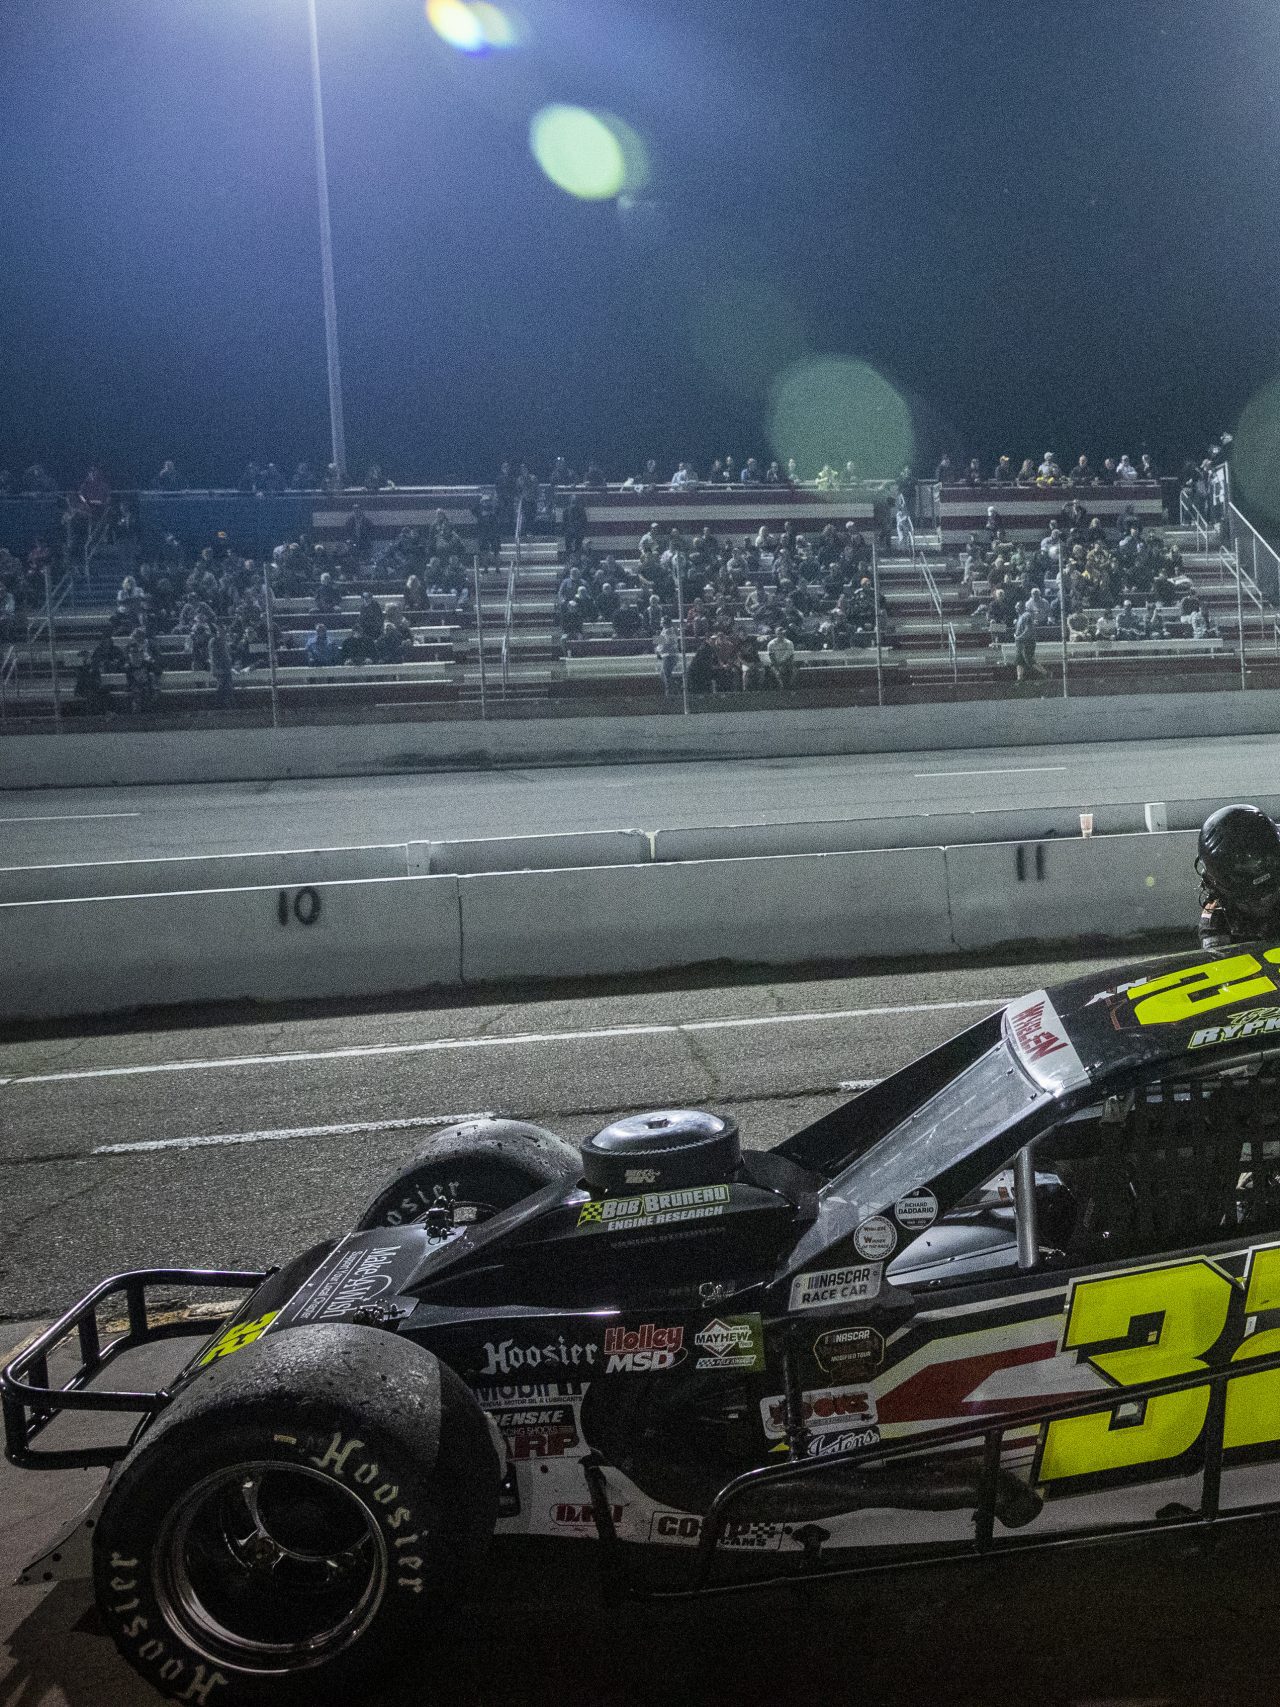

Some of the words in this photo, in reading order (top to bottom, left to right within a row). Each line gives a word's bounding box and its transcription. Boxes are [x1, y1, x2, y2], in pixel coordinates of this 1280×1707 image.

[277, 885, 321, 926] 10
[1011, 1001, 1068, 1062] WHELEN
[386, 1181, 459, 1226] osier
[898, 1207, 934, 1215] DADDARIO
[608, 1216, 655, 1232] ENGINE
[655, 1205, 723, 1225] RESEARCH
[818, 1268, 871, 1289] NASCAR
[802, 1287, 840, 1303] RACE
[842, 1284, 868, 1298] CAR
[604, 1324, 684, 1352] Holley
[696, 1331, 749, 1345] MAYHEW
[836, 1330, 871, 1342] NASCAR
[480, 1335, 598, 1375] Hoosier
[606, 1350, 674, 1374] MSD
[857, 1351, 872, 1359] TOUR
[500, 1410, 565, 1427] ENSKE
[310, 1432, 424, 1594] Hoosier
[657, 1515, 750, 1538] COP
[719, 1537, 767, 1548] CAMS
[109, 1551, 229, 1706] Hoosier
